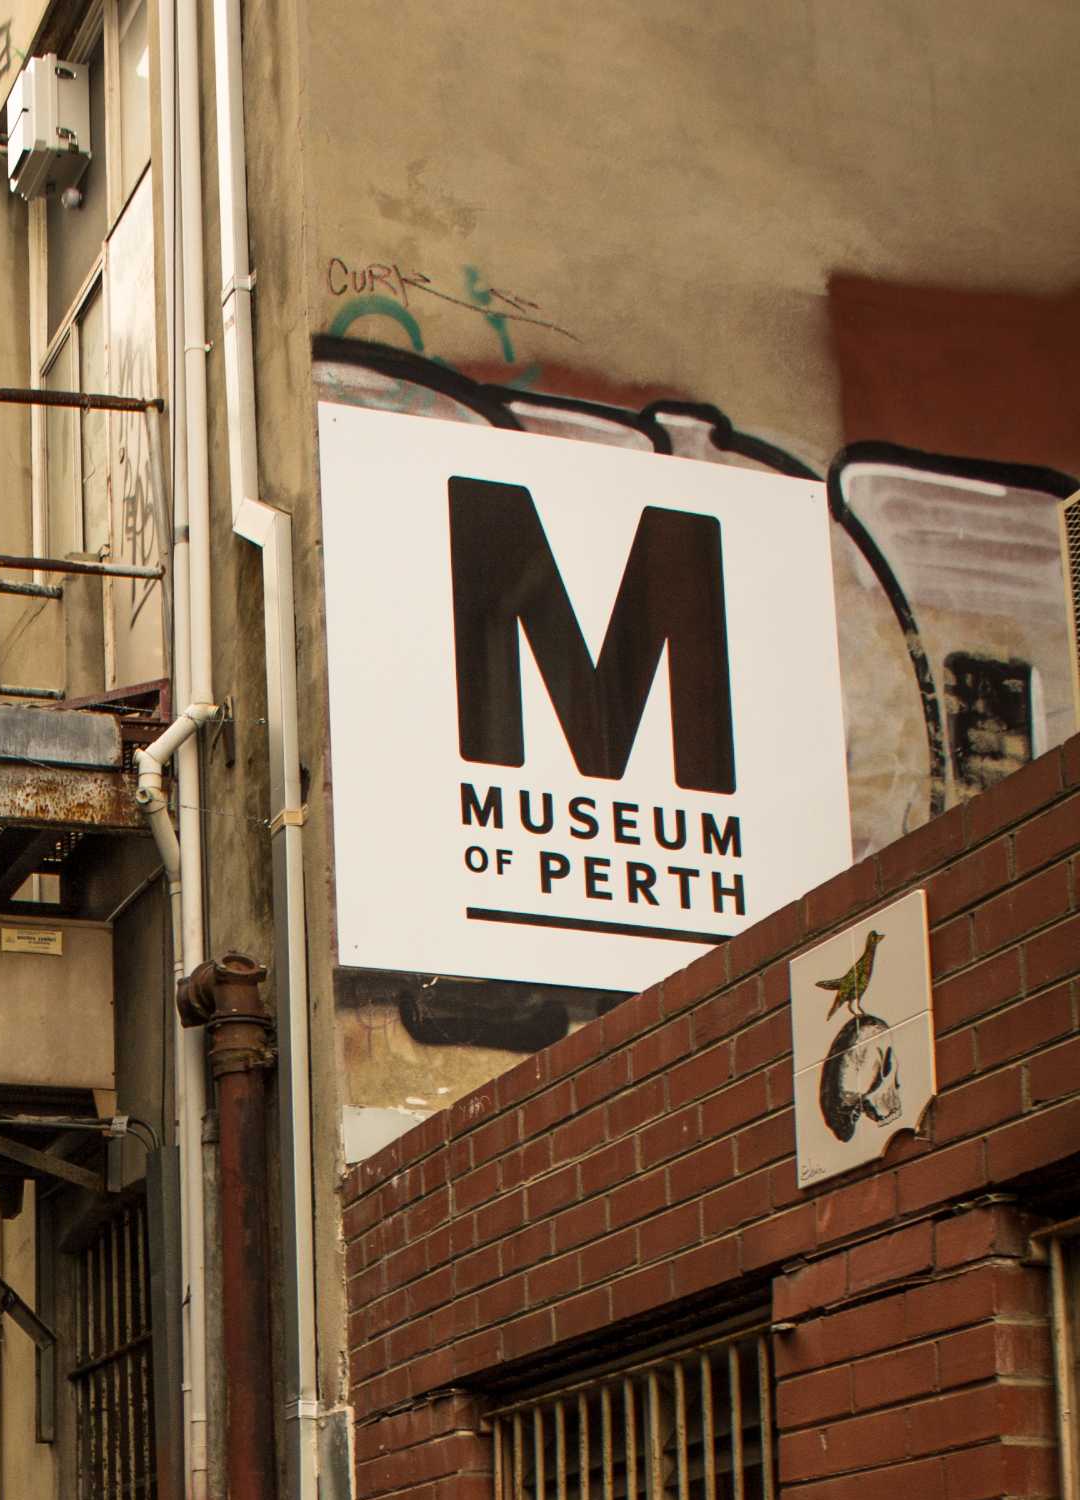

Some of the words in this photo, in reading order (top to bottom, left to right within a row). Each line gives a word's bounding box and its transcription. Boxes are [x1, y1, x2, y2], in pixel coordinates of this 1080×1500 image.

[447, 475, 737, 796] M
[460, 782, 743, 858] MUSEUM
[464, 845, 514, 875] OF
[539, 850, 747, 916] PERTH
